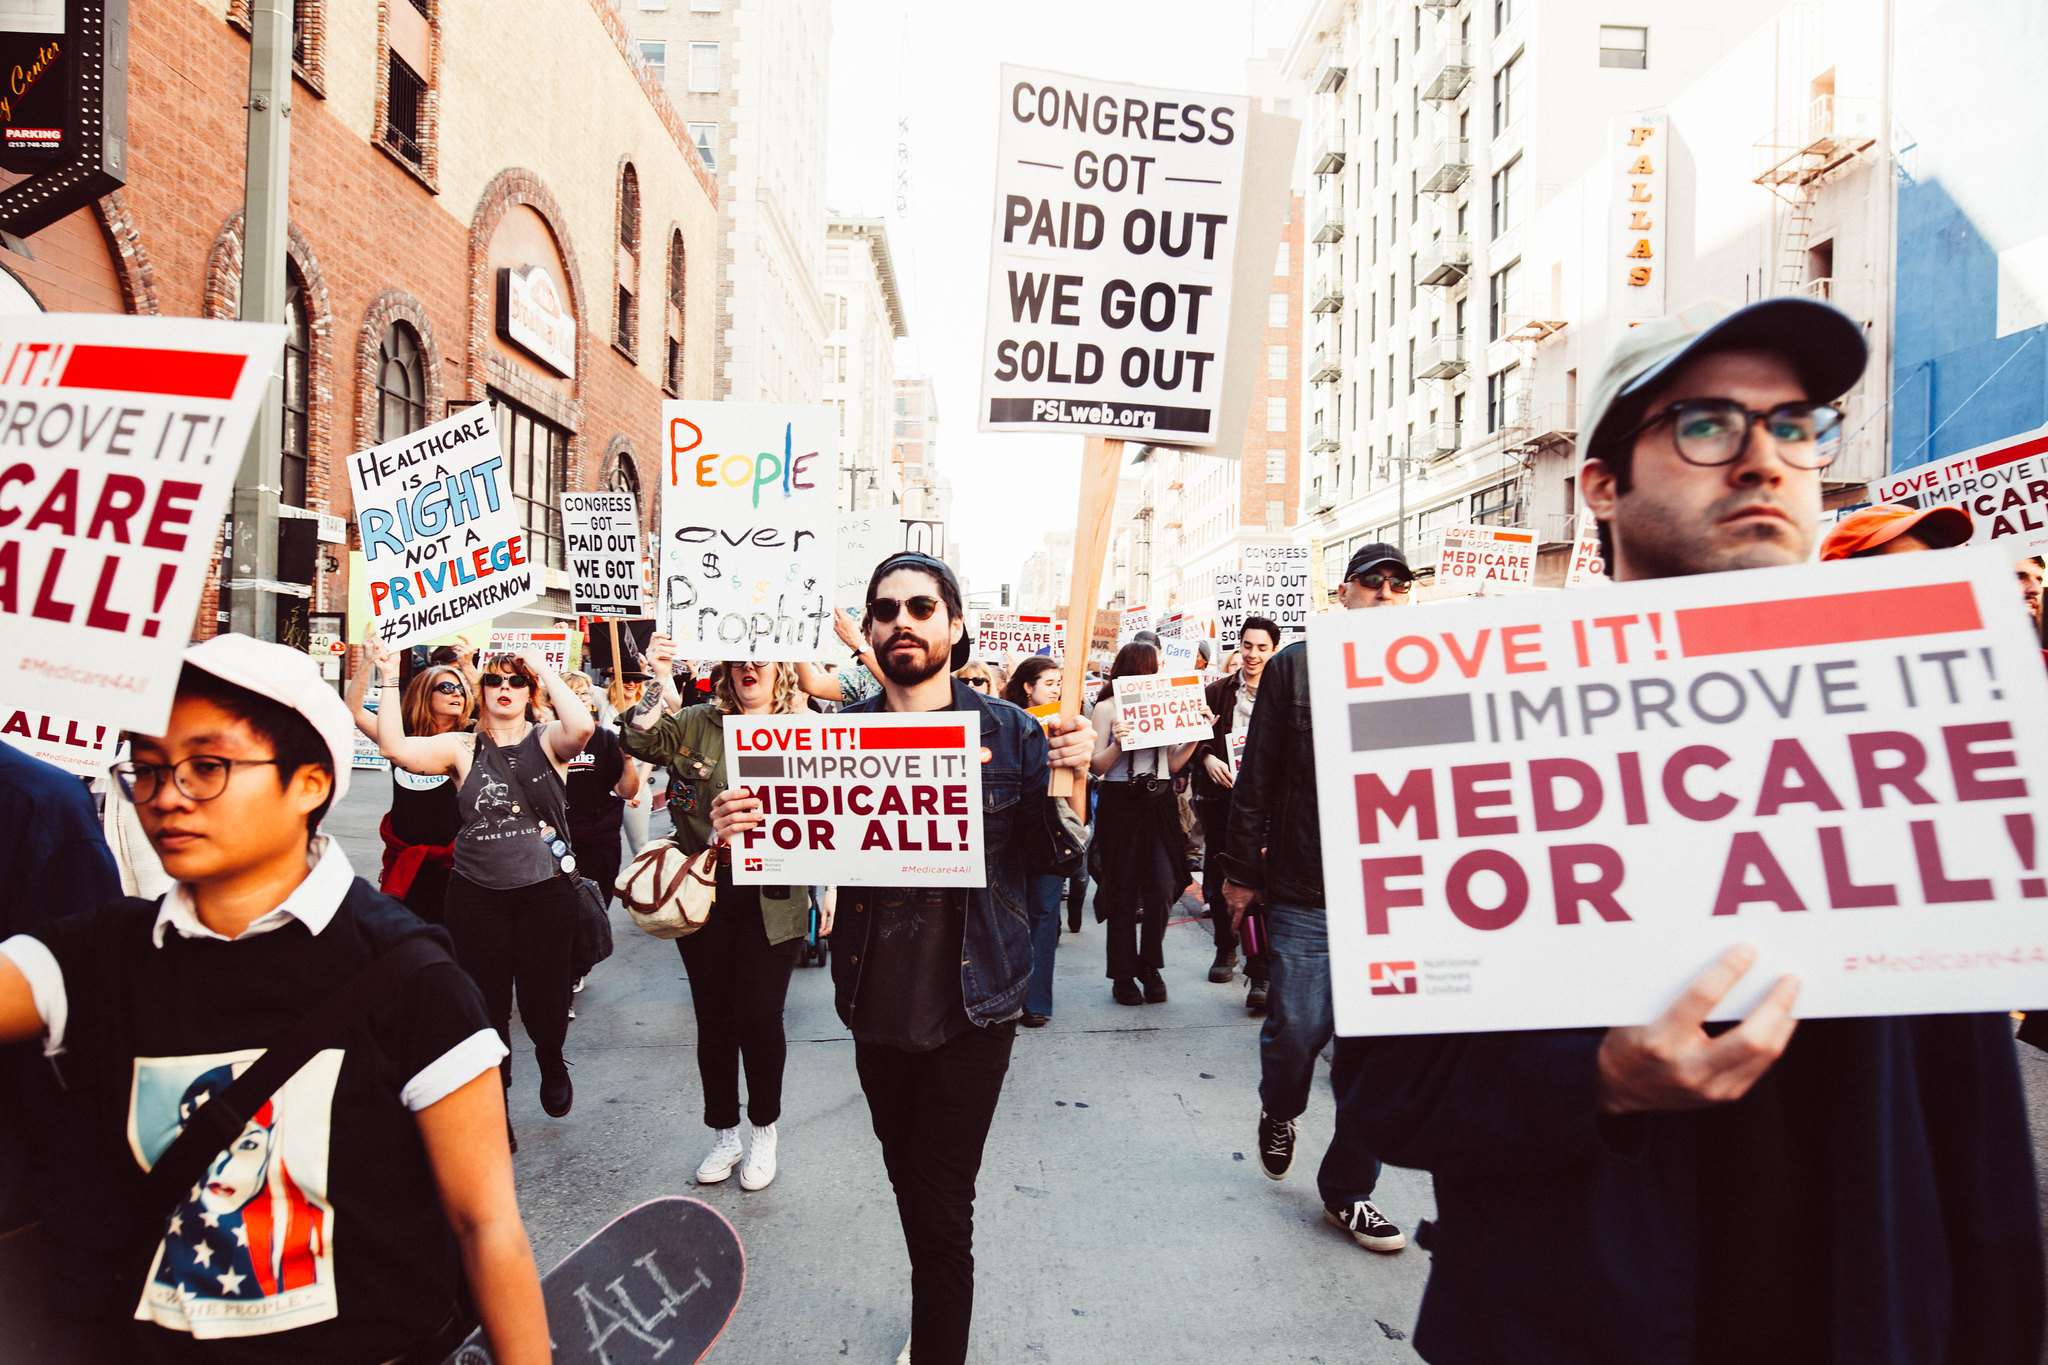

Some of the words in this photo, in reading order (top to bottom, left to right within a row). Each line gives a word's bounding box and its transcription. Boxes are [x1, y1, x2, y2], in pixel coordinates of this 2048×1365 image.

[12, 42, 60, 95] Center
[1012, 82, 1235, 146] CONGRESS
[6, 129, 61, 139] PARKING
[1074, 150, 1156, 195] GOT
[1626, 127, 1656, 287] FALLAS
[1003, 194, 1105, 250] PAID
[1123, 208, 1228, 260] OUT
[1007, 270, 1084, 326] WE
[1101, 278, 1213, 335] GOT
[2, 342, 63, 387] IT!
[994, 340, 1105, 385] SOLD
[1120, 347, 1215, 393] OUT
[1032, 399, 1156, 429] PSLweb.org
[154, 411, 225, 465] IT!
[357, 417, 489, 491] HEALTHCARE
[402, 474, 422, 491] IS
[435, 464, 449, 480] A
[1880, 470, 1939, 502] LOVE
[1945, 459, 1974, 482] IT!
[1922, 462, 2032, 508] IMPROVE
[360, 456, 503, 561] RIGHT
[564, 497, 632, 512] CONGRESS
[591, 516, 612, 531] GOT
[1446, 528, 1475, 538] LOVE
[1991, 503, 2048, 540] AL
[405, 535, 451, 569] NOT
[465, 528, 480, 547] A
[568, 534, 602, 552] PAID
[607, 535, 636, 552] OUT
[675, 527, 815, 552] over
[1246, 547, 1308, 559] CONGRESS
[574, 560, 600, 578] WE
[605, 560, 635, 579] GOT
[1265, 562, 1287, 572] GOT
[1441, 563, 1476, 577] FOR
[1486, 567, 1527, 582] ALL!
[1442, 550, 1530, 568] MEDICARE
[0, 540, 178, 638] ALL!
[370, 535, 526, 617] PRIVILEGE
[1246, 575, 1275, 588] PAID
[1281, 575, 1307, 587] OUT
[575, 583, 610, 599] SOLD
[614, 585, 639, 600] OUT
[1248, 594, 1269, 606] WE
[1276, 593, 1304, 607] GOT
[380, 573, 531, 643] #SINGLEPAYERNOW
[667, 575, 831, 654] Prophit
[980, 613, 1004, 621] LOVE
[1221, 615, 1242, 628] WE
[1282, 611, 1306, 622] OUT
[979, 641, 1008, 652] FOR
[980, 631, 1050, 643] MEDICARE
[1166, 644, 1191, 657] Care
[1343, 624, 1548, 689] LOVE
[1572, 613, 1668, 668] IT!
[1120, 681, 1152, 693] LOVE
[1485, 660, 1868, 743] IMPROVE
[1901, 647, 2006, 709] IT!
[1123, 699, 1202, 720] MEDICARE
[1, 710, 106, 751] ALL!
[736, 729, 811, 751] LOVE
[821, 728, 855, 750] IT!
[789, 755, 921, 779] IMPROVE
[933, 755, 967, 777] IT!
[1353, 721, 2030, 845] MEDICARE
[740, 785, 968, 815] MEDICARE
[743, 818, 836, 850] FOR
[861, 820, 969, 851] ALL!
[901, 865, 972, 874] #Medicare4All
[1361, 843, 1634, 936] FOR
[1711, 813, 2048, 917] ALL!
[223, 1297, 300, 1317] PEOPLE
